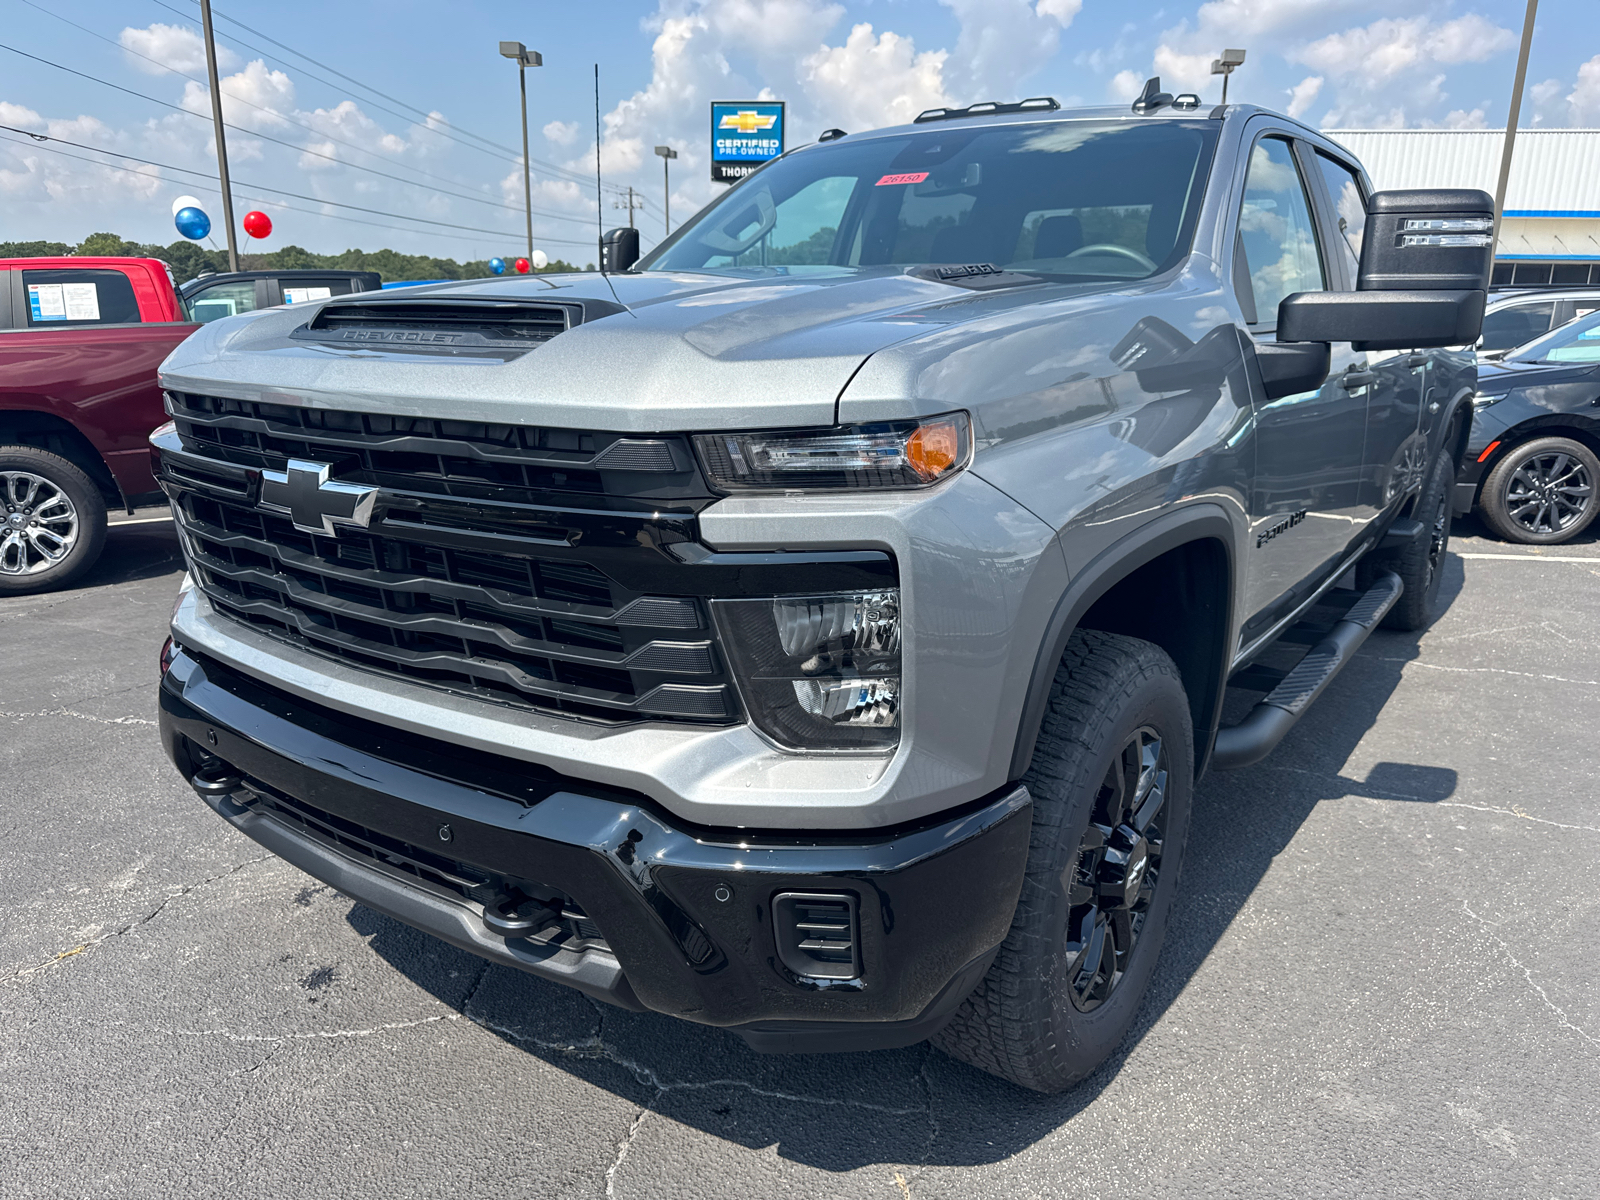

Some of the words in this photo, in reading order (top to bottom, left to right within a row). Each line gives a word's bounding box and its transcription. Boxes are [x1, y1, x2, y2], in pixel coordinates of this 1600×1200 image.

[716, 139, 780, 148] CERTIFIED
[719, 147, 776, 156] PRE-OWNED
[883, 174, 920, 184] 26150
[343, 330, 463, 343] CHEVROLET
